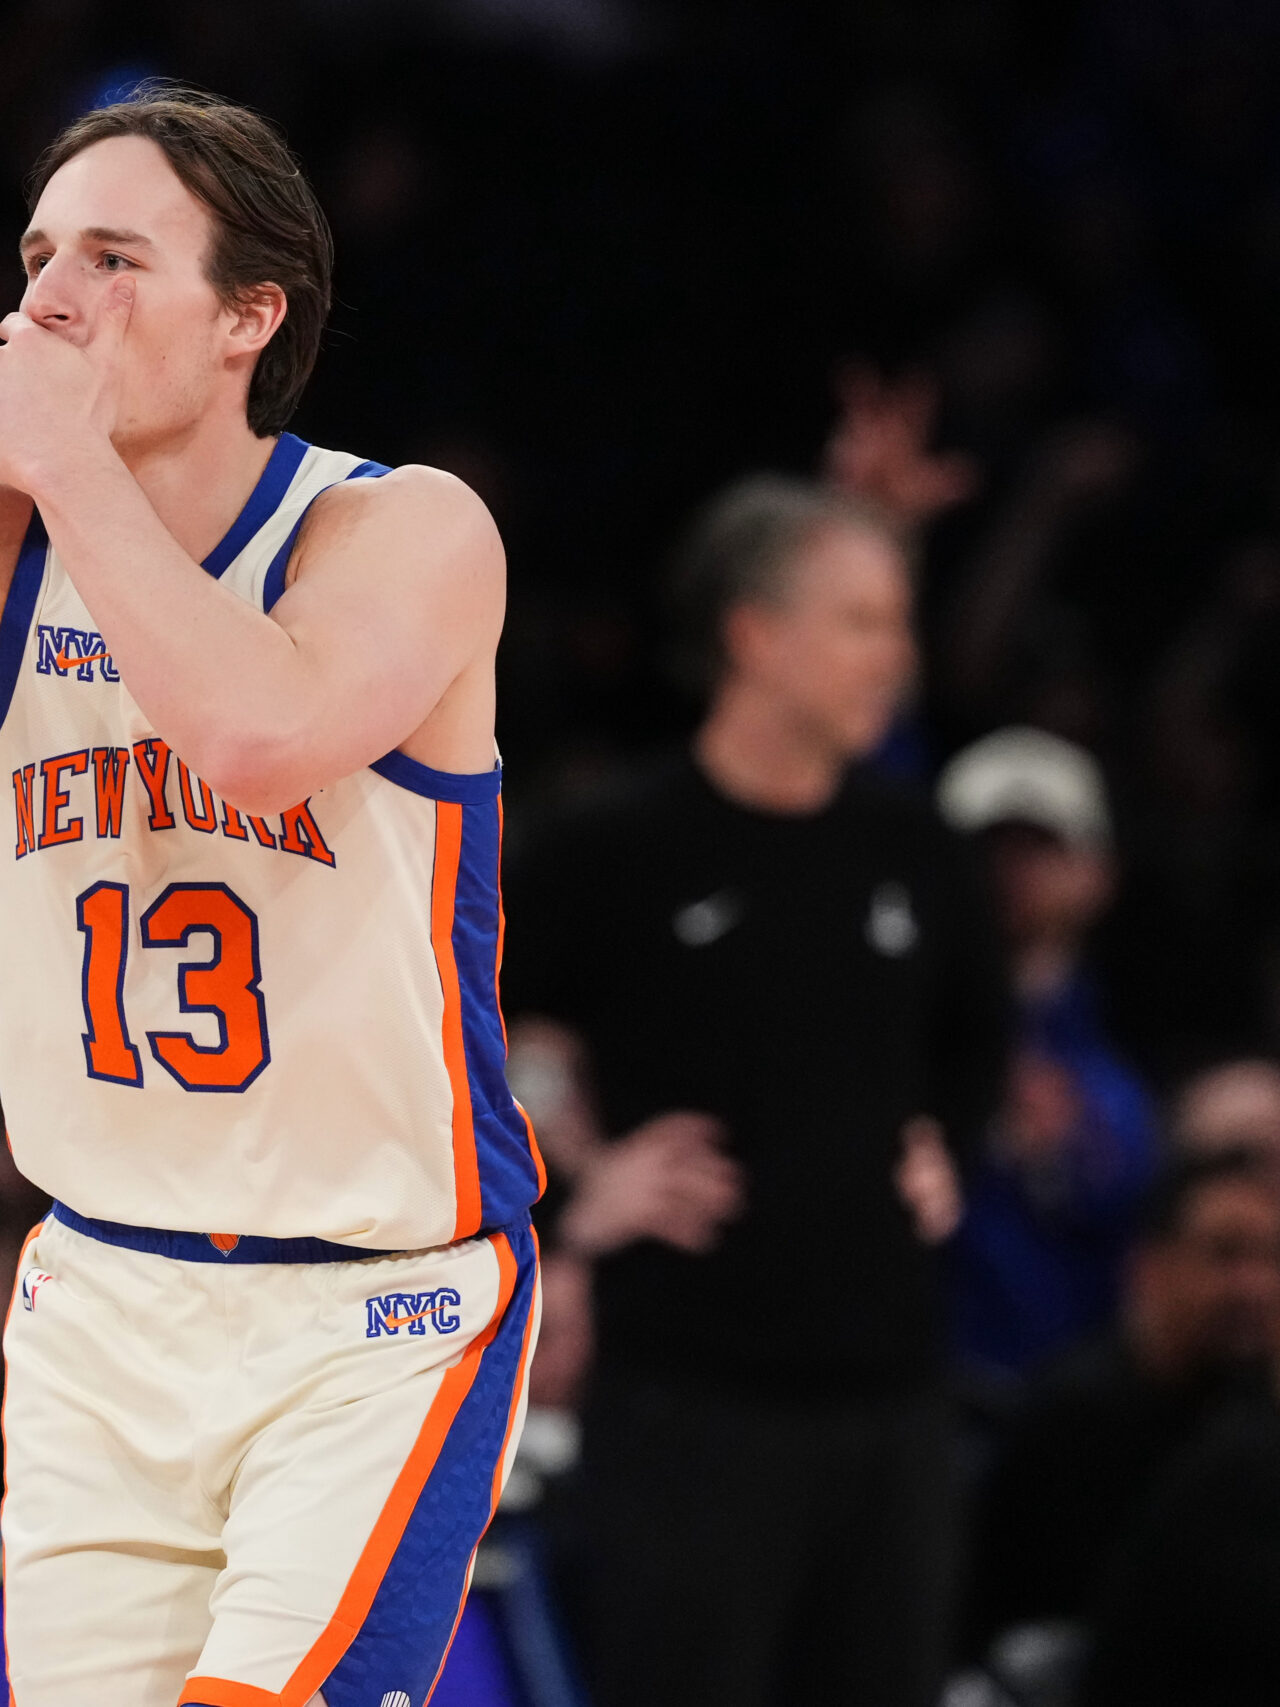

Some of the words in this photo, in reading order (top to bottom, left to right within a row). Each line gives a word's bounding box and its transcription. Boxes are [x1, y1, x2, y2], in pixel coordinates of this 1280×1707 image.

[12, 747, 129, 860] NEW
[76, 880, 271, 1093] 13
[366, 1287, 460, 1338] NYC
